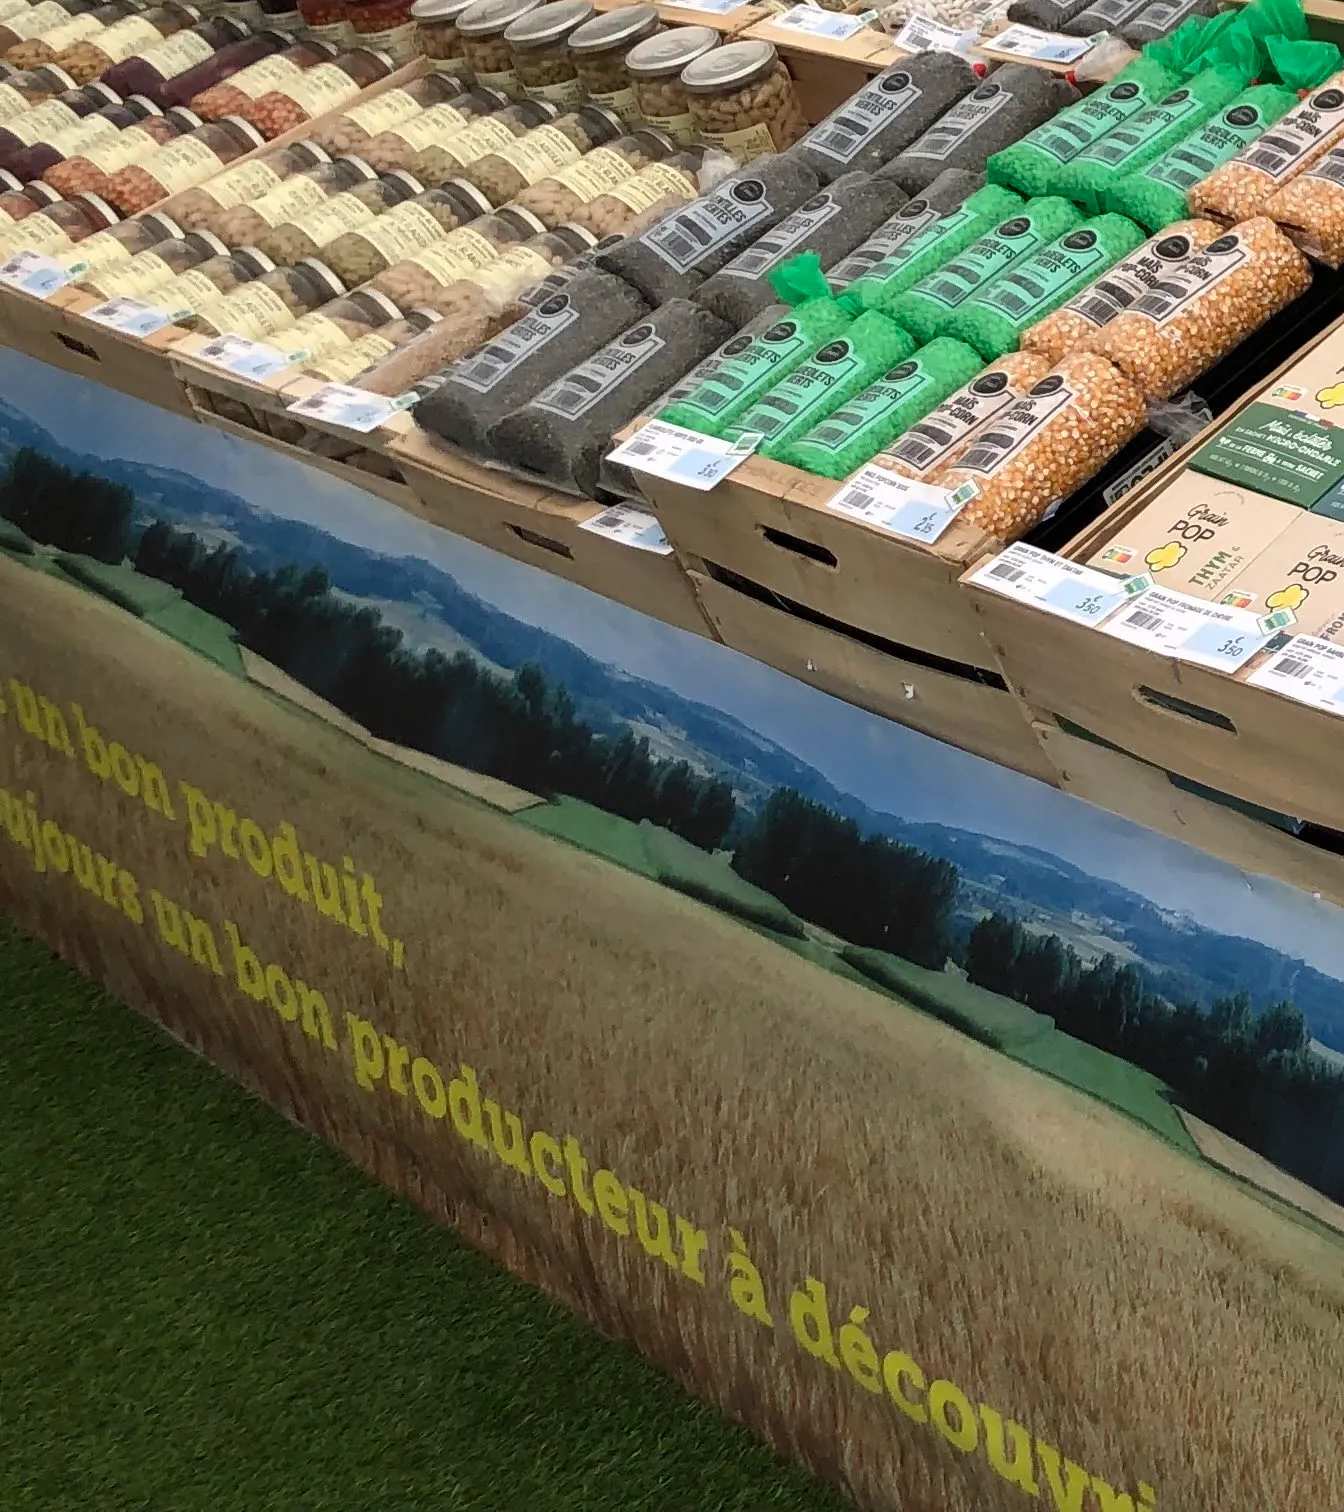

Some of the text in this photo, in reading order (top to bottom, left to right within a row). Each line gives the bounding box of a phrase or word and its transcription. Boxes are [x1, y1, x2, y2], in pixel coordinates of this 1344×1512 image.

[1188, 546, 1231, 588] THYM
[10, 679, 404, 968] un bon produit,
[150, 890, 225, 976] un
[224, 920, 338, 1051] bon
[347, 1012, 709, 1285] producteur
[727, 1226, 773, 1327] à
